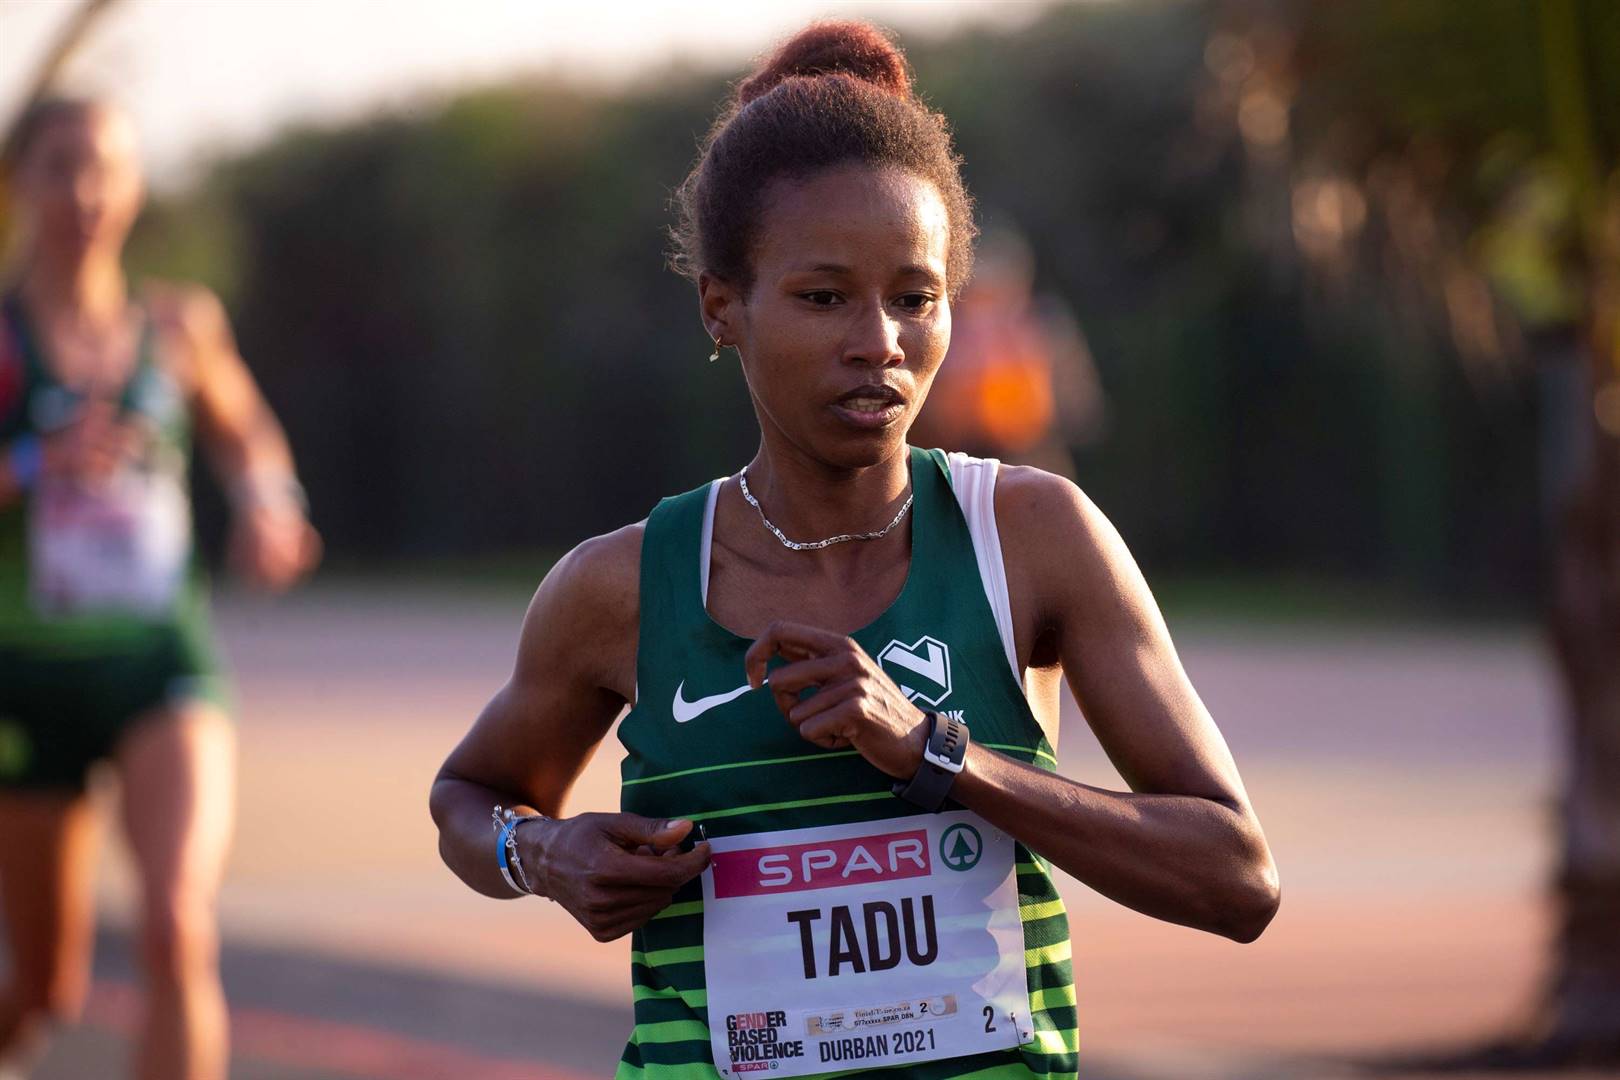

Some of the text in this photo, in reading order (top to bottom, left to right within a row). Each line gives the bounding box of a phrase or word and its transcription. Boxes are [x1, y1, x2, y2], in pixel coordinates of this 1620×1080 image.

[758, 838, 926, 887] SPAR
[787, 894, 939, 980] TADU
[882, 1013, 900, 1023] SPAR
[919, 1002, 928, 1013] 2
[726, 1010, 787, 1031] GENDER
[983, 1005, 997, 1033] 2
[728, 1027, 778, 1047] BASED
[819, 1028, 936, 1063] DURBAN 2021
[730, 1040, 804, 1063] VIOLENCE
[739, 1062, 769, 1072] SPAR
